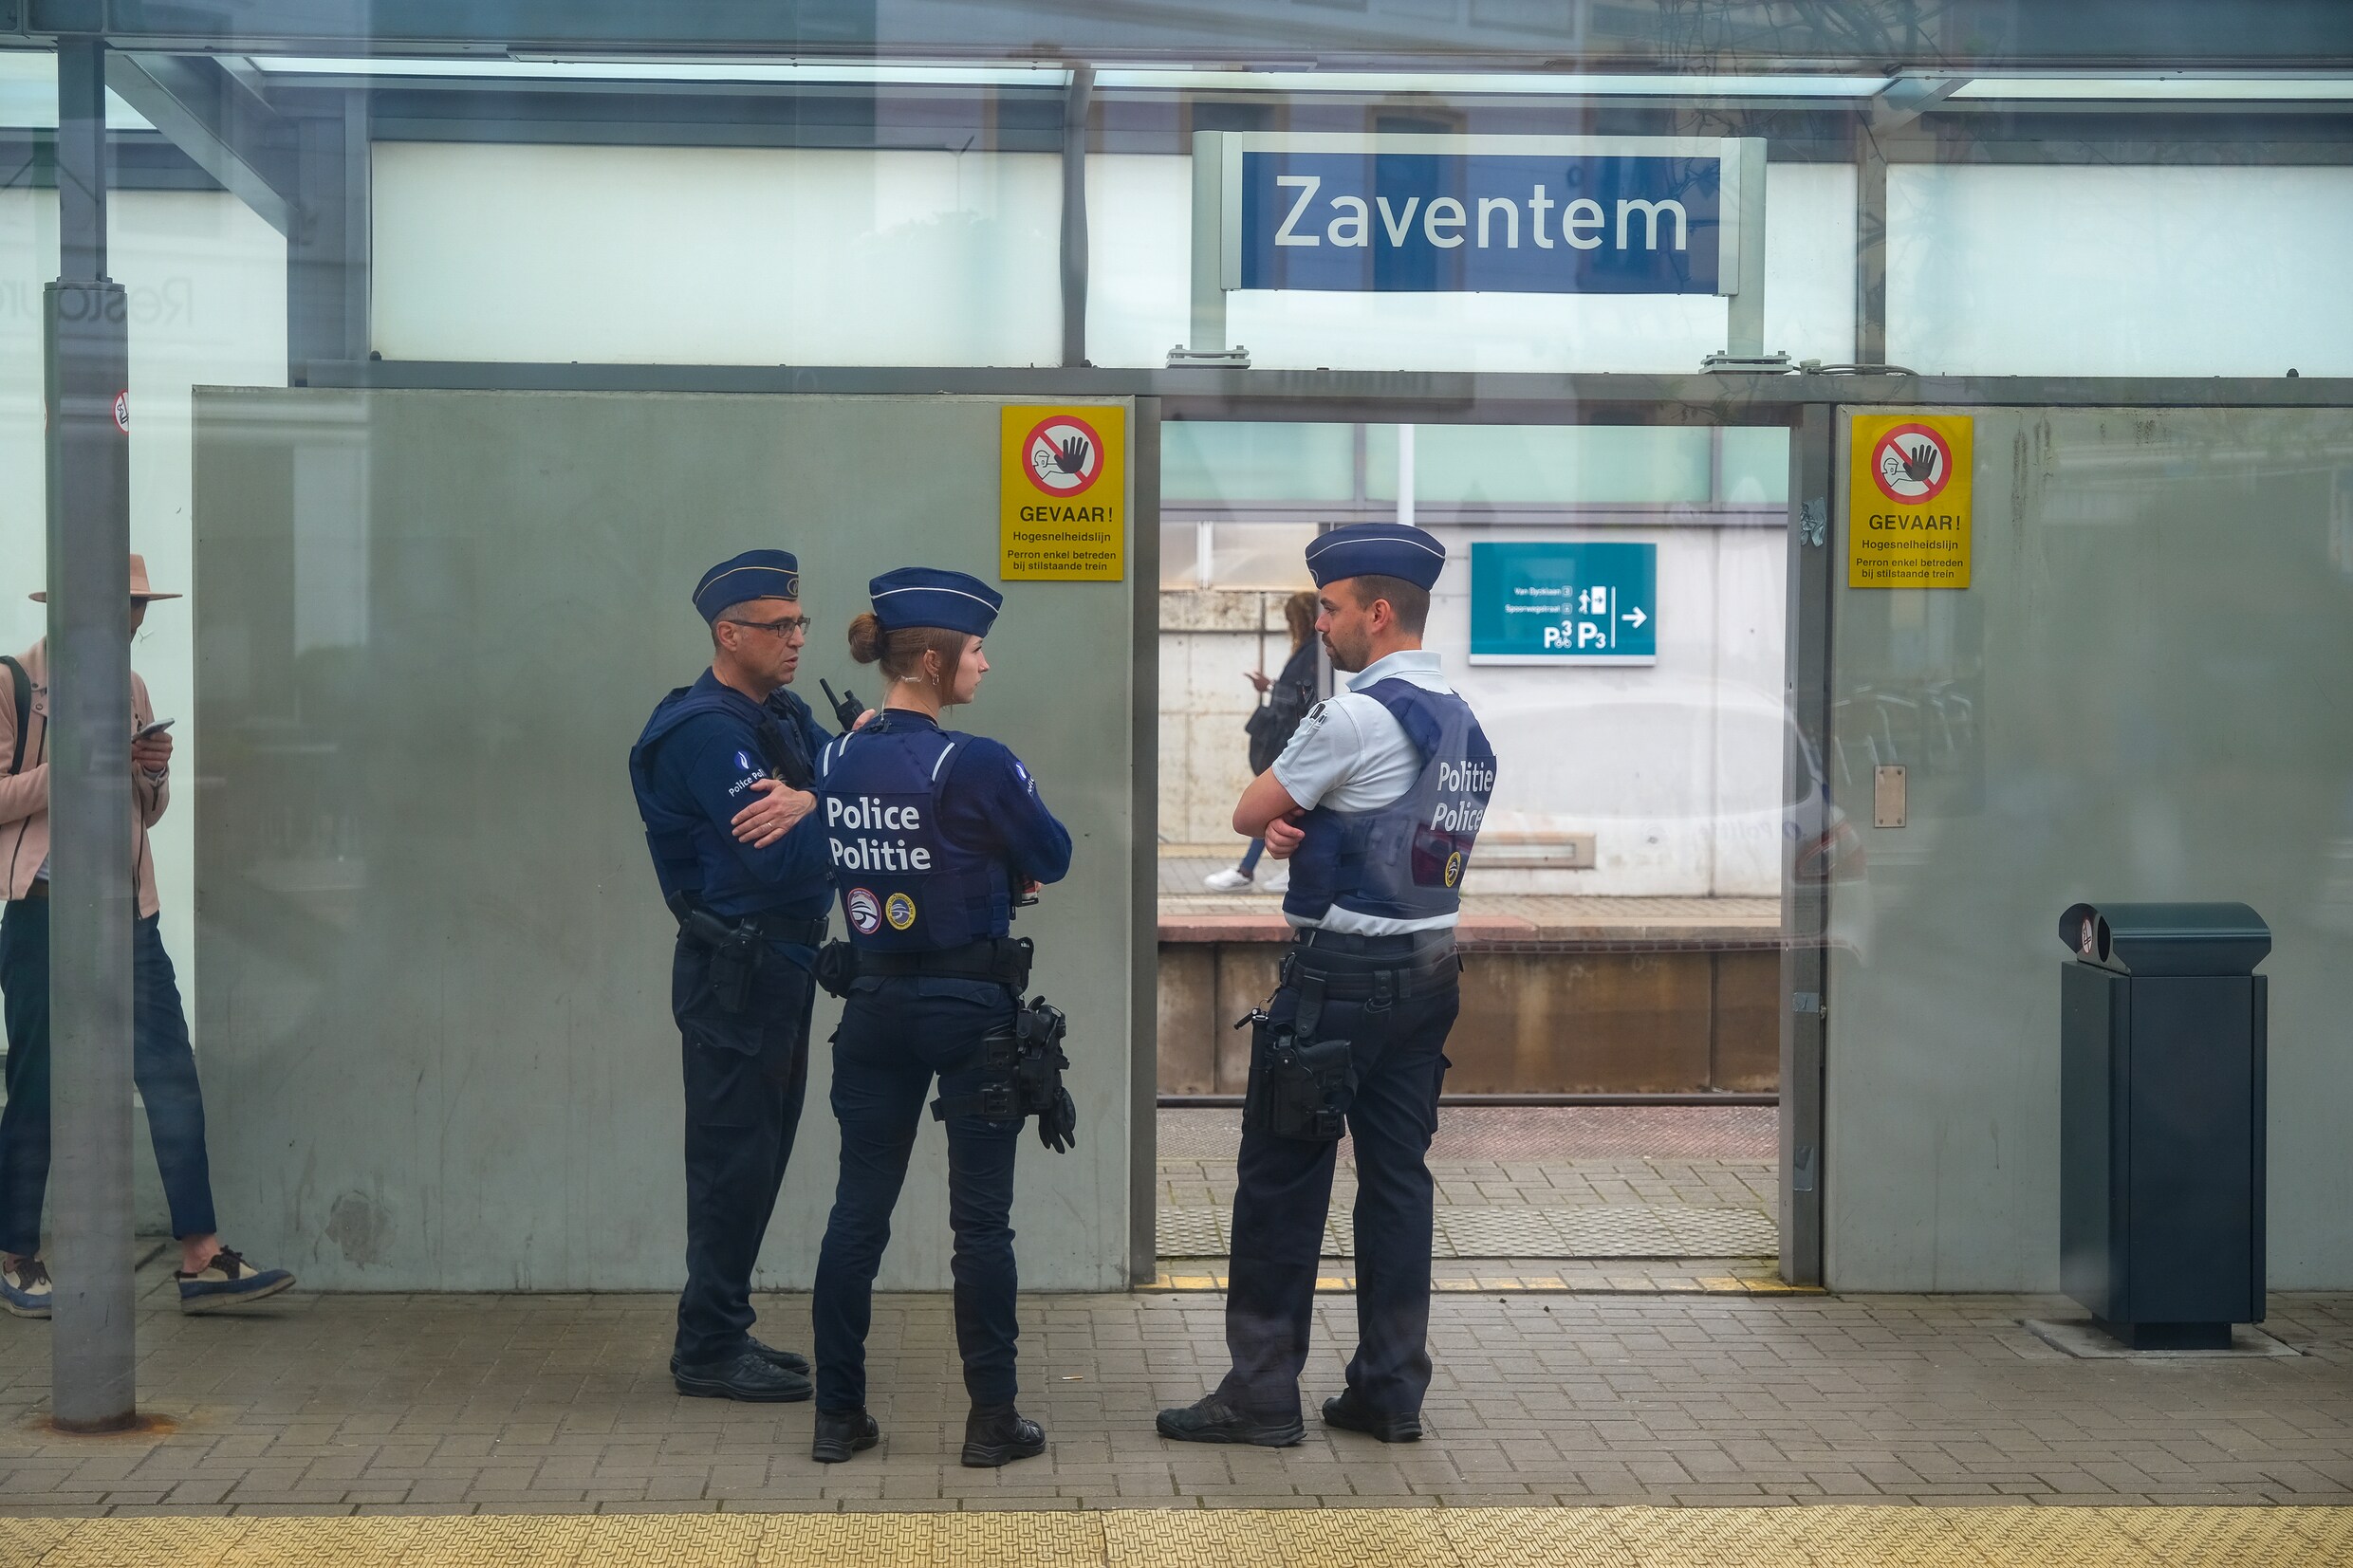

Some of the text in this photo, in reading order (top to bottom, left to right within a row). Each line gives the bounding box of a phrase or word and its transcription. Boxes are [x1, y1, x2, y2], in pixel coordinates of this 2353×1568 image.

[1274, 175, 1688, 250] Zaventem
[1012, 531, 1111, 544] Hogesnelheidslijn
[1862, 539, 1958, 551] Hogesnelheidslijn
[1008, 549, 1117, 560] Perron enkel betreden
[1856, 558, 1963, 567] Perron enkel betreden
[1013, 561, 1107, 572] bij stilstaande trein
[1862, 569, 1955, 580] bij stilstaande trein
[1437, 761, 1493, 792] Politie
[729, 776, 752, 797] Police
[826, 796, 920, 830] Police
[1430, 802, 1484, 832] Police
[828, 837, 932, 871] Politie
